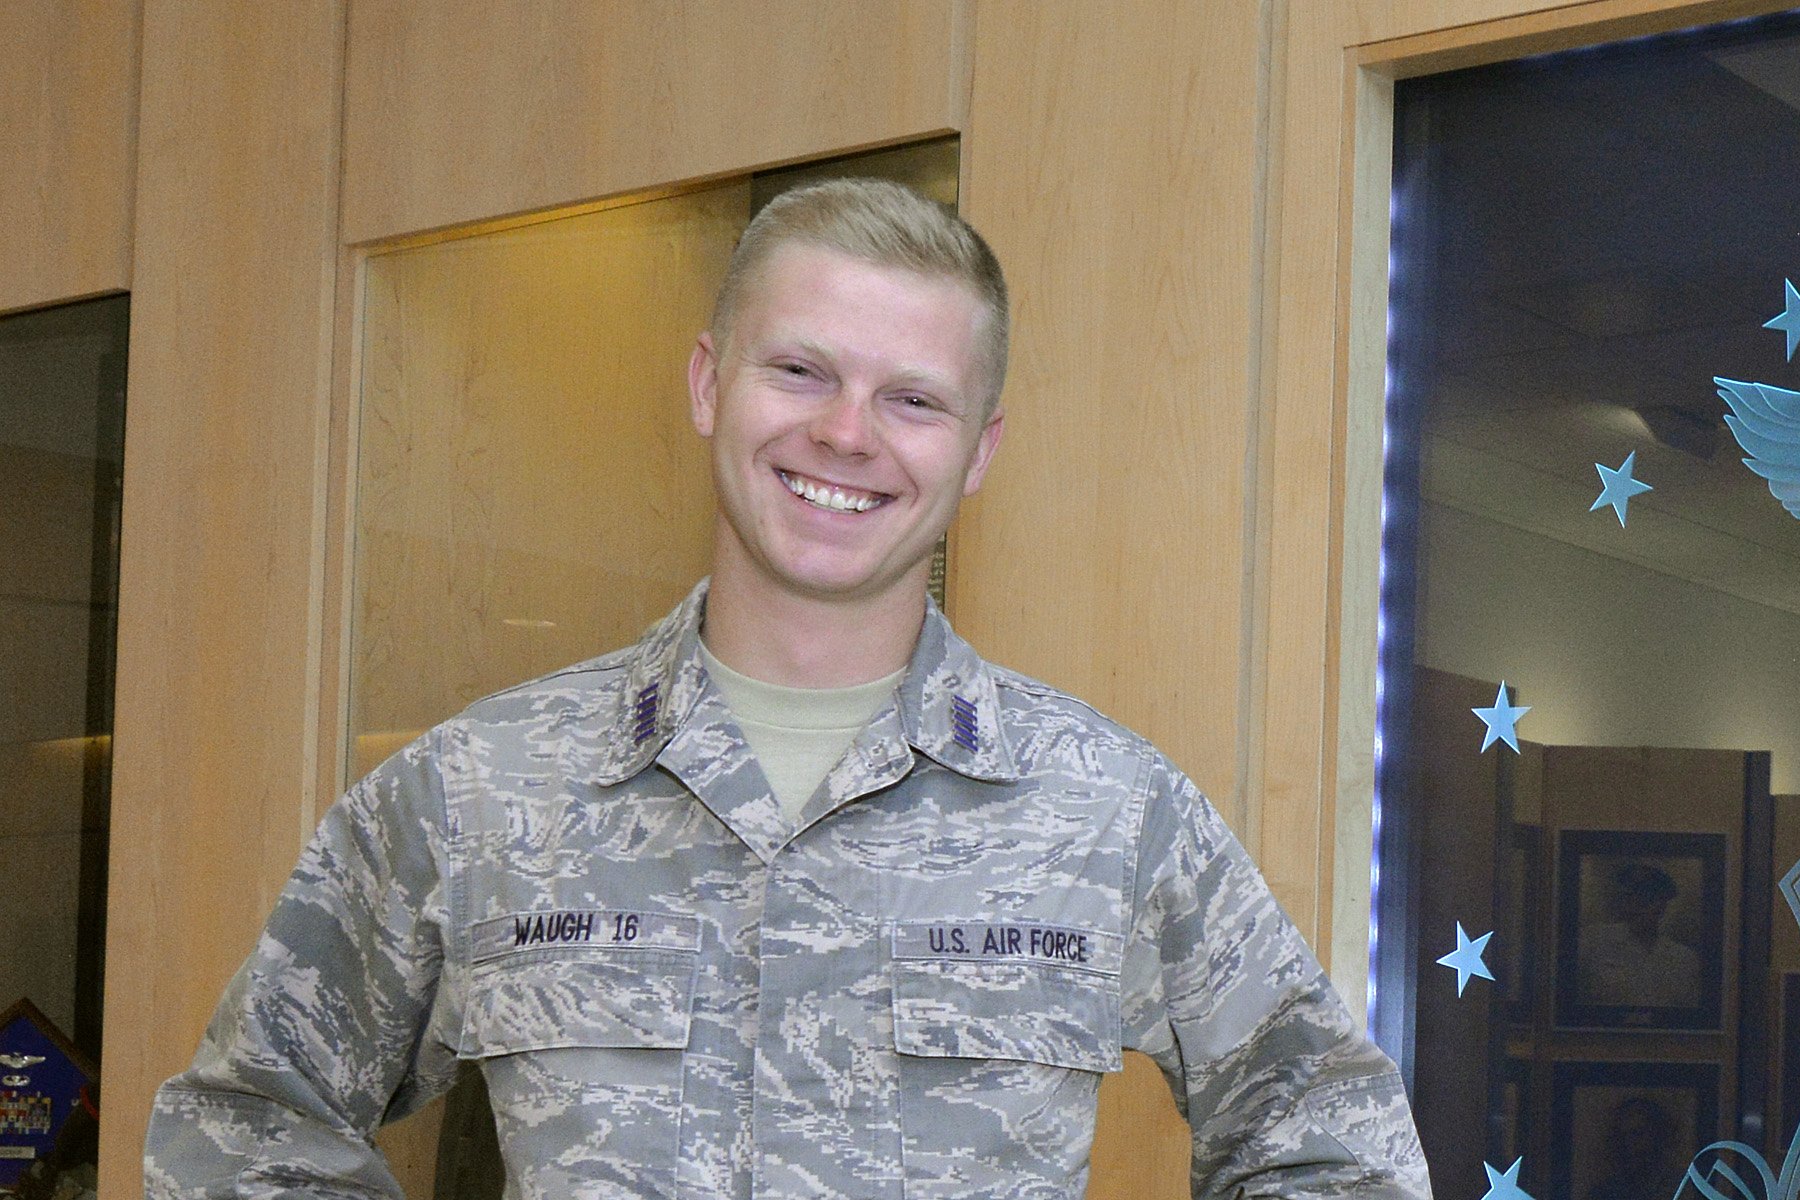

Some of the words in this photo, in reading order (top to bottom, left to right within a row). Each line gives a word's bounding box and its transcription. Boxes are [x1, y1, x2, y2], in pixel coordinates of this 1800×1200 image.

[514, 913, 593, 946] WAUGH
[612, 914, 639, 941] 16
[928, 927, 970, 954] U.S.
[982, 927, 1021, 955] AIR
[1030, 929, 1087, 962] FORCE
